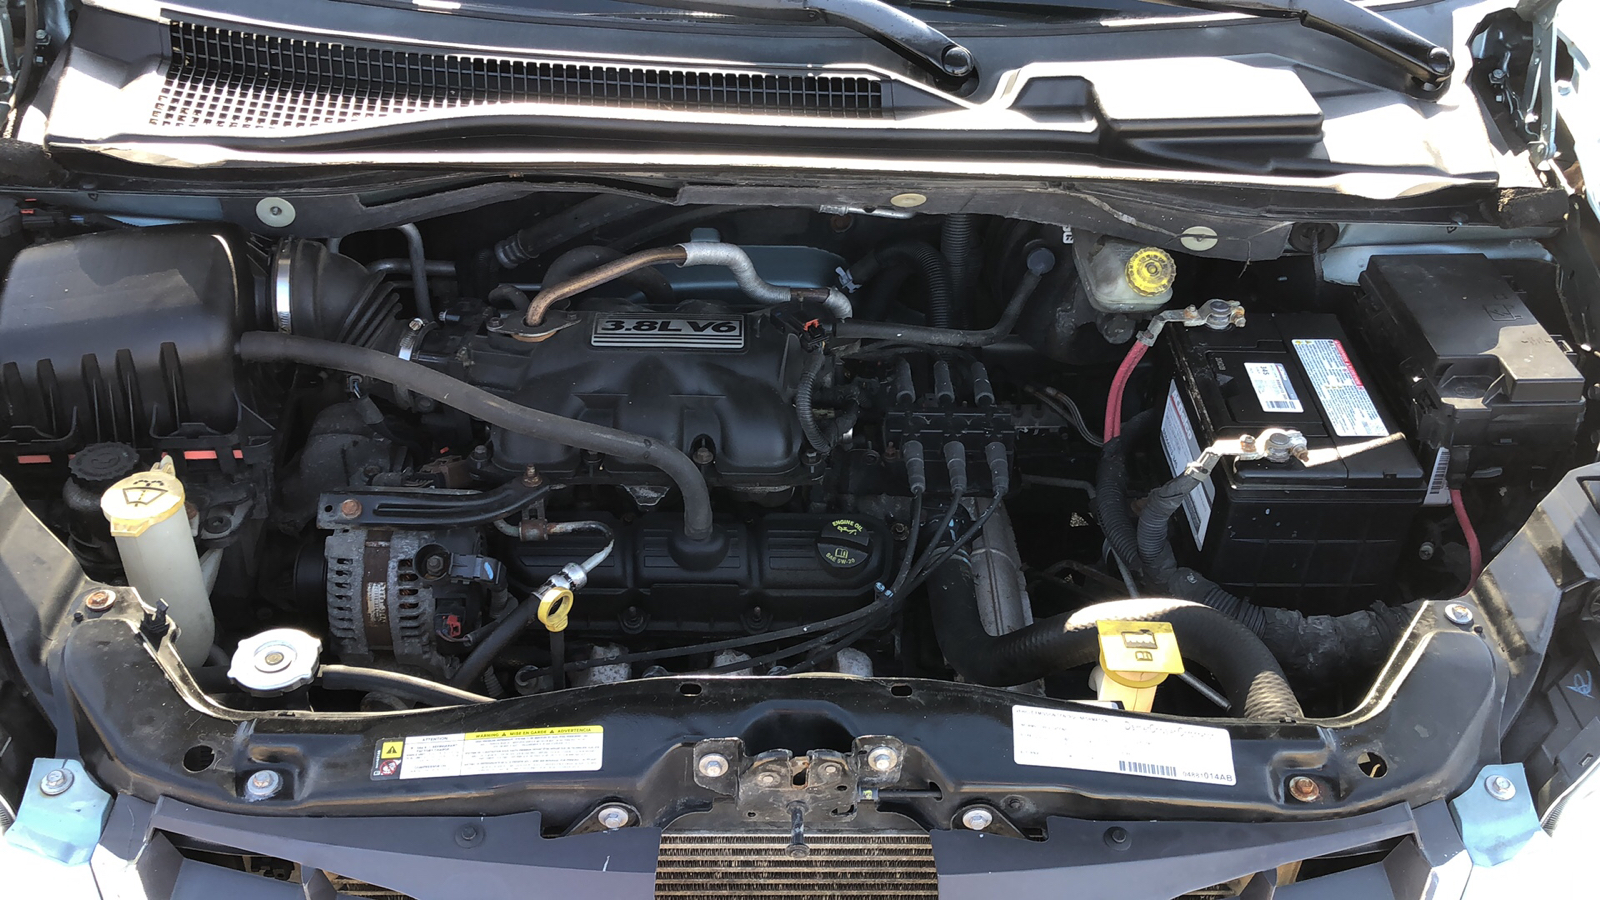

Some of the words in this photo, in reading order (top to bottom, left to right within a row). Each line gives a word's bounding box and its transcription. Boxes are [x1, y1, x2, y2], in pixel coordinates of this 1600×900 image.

[601, 320, 682, 332] 3.8L
[686, 321, 737, 333] V6
[832, 519, 854, 527] ENGINE
[854, 522, 864, 533] OIL
